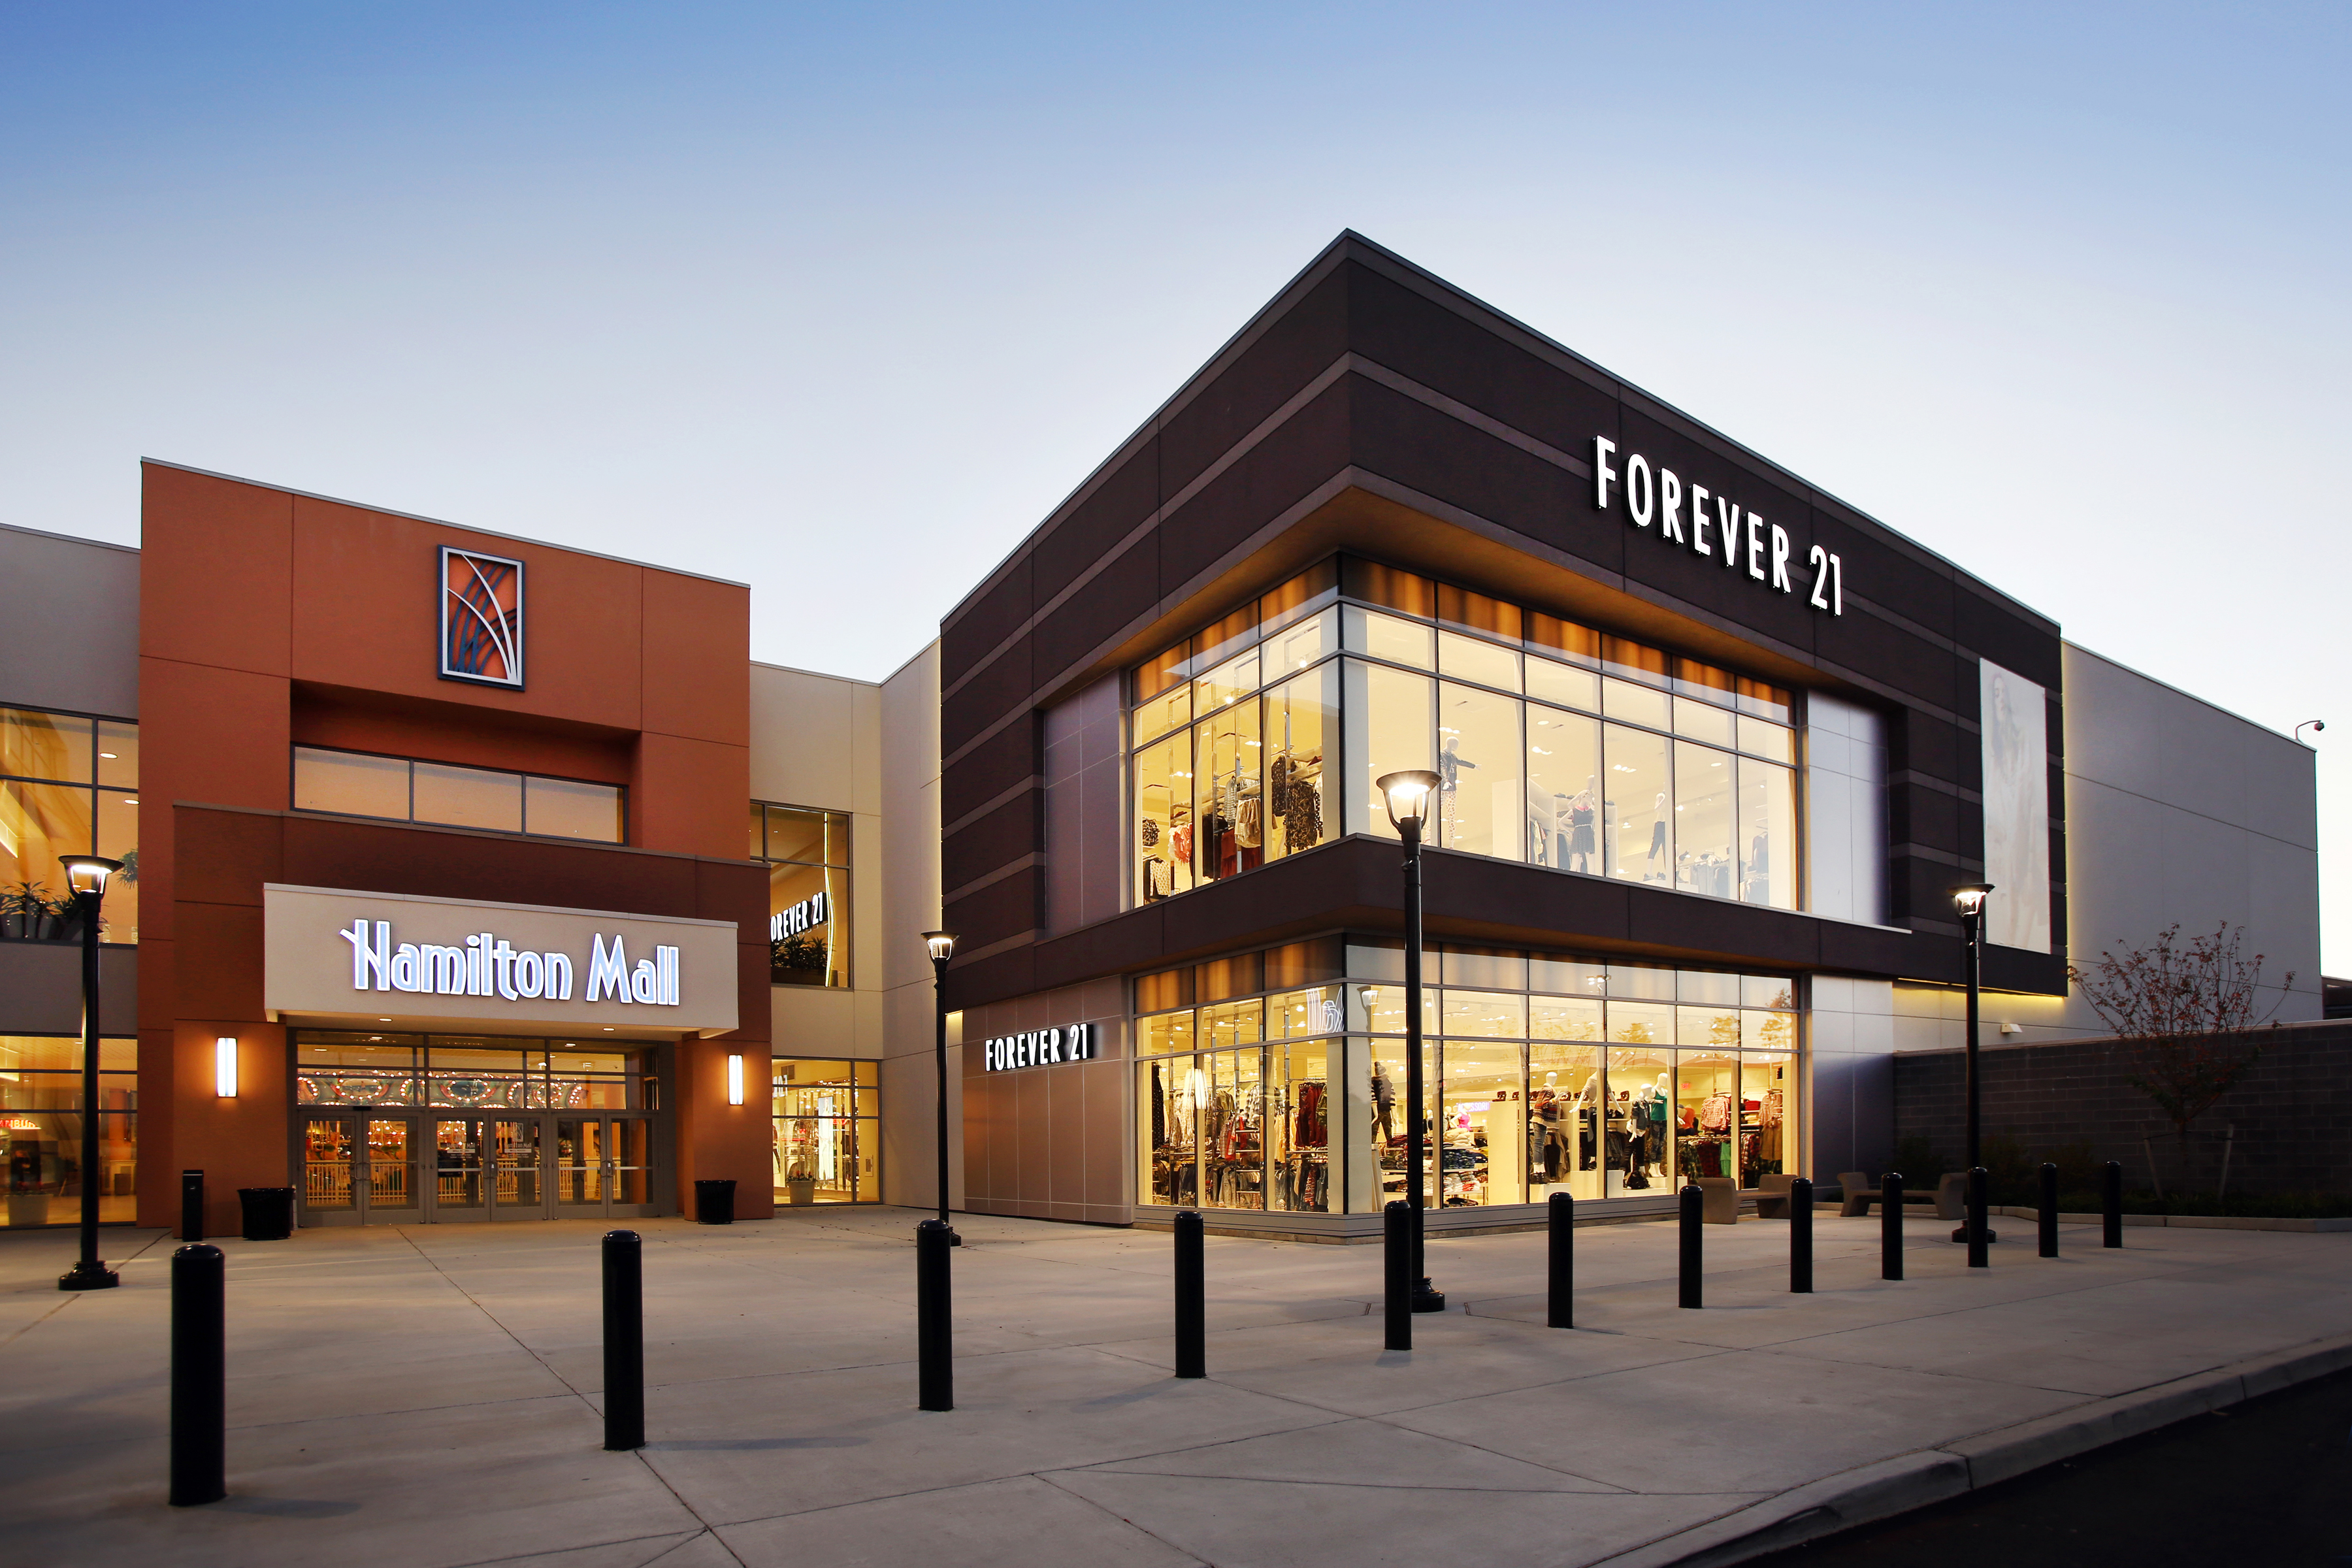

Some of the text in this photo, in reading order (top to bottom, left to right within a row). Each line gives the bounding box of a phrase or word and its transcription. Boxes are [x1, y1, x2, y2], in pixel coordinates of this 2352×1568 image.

[1593, 434, 1842, 616] FOREVER 21
[811, 891, 823, 925] 21
[338, 918, 680, 1006] Hamilton Mall
[985, 1022, 1088, 1071] FOREVER 21
